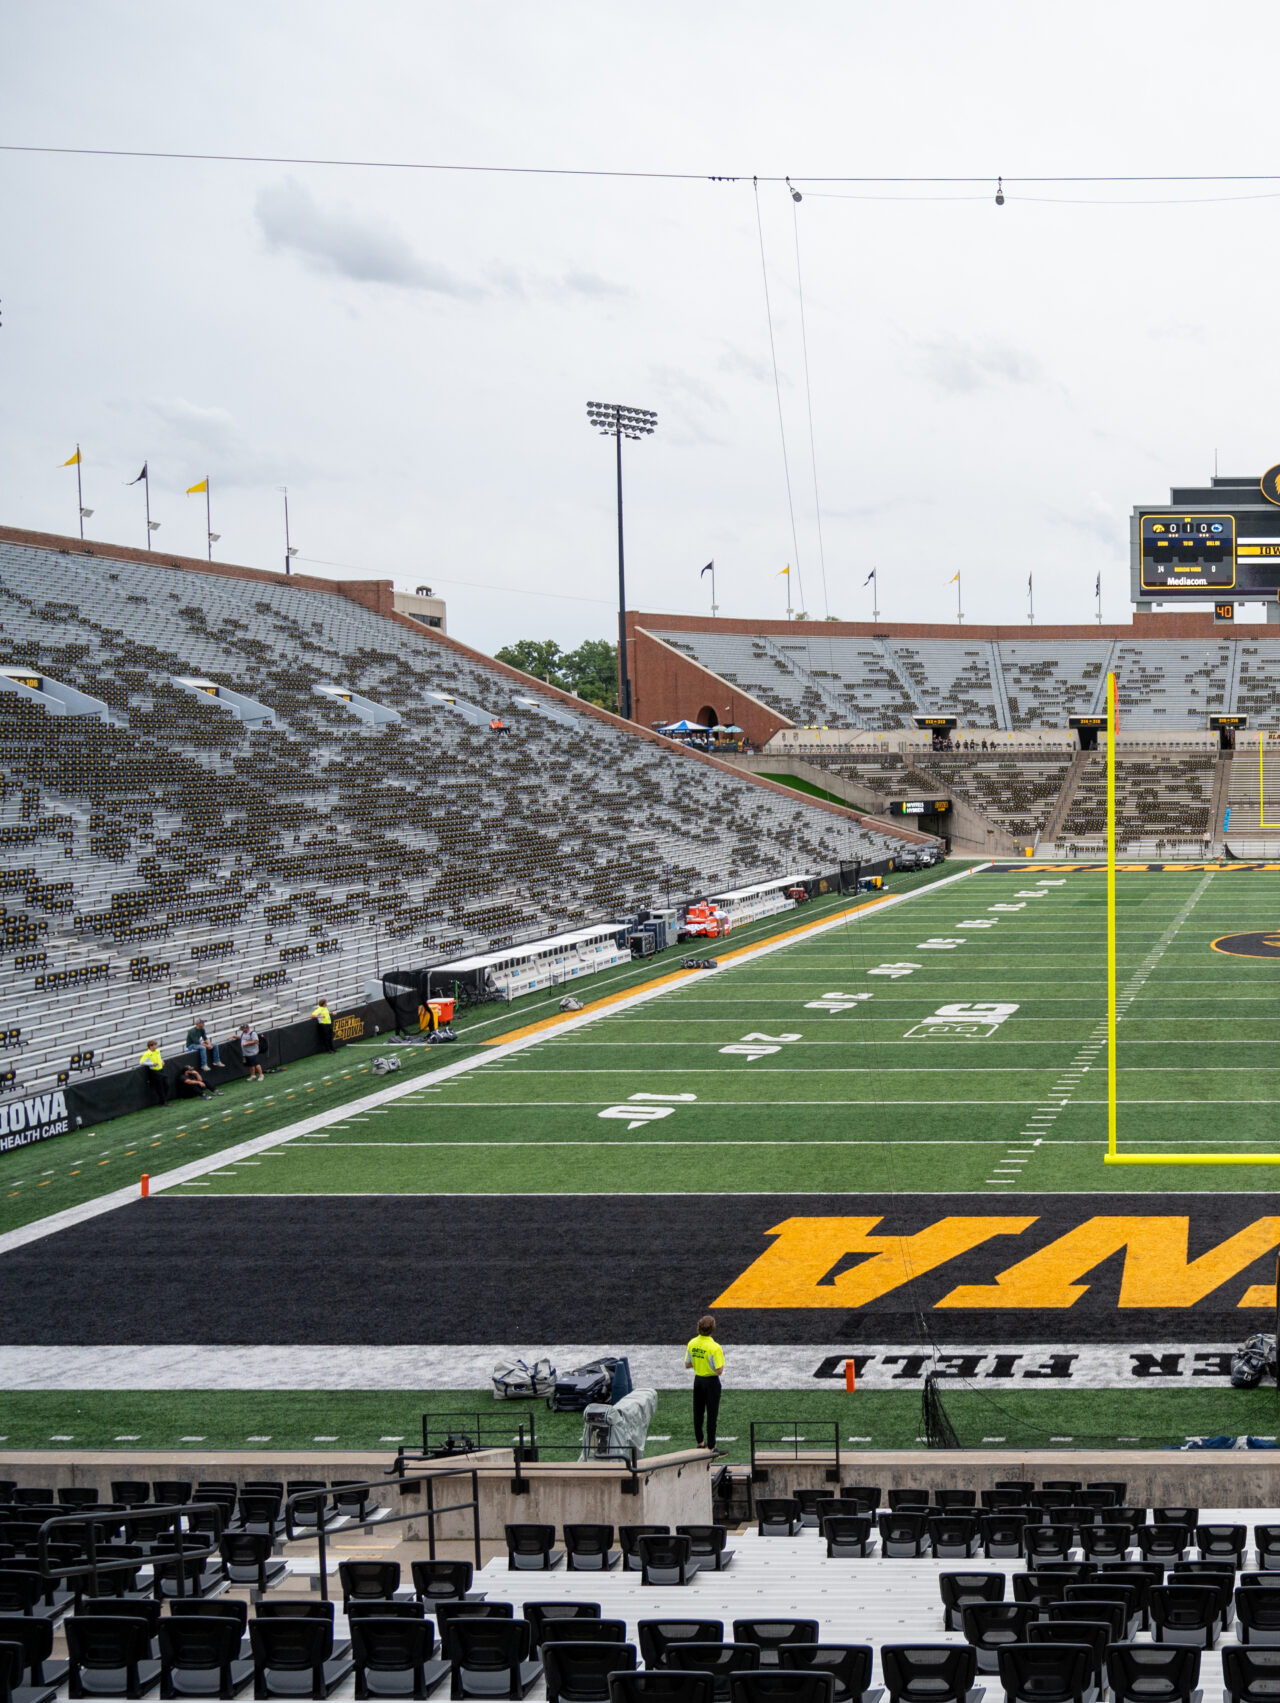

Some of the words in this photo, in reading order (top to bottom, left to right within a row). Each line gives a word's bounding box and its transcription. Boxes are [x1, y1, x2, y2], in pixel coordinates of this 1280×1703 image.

[1170, 524, 1177, 533] 0
[1201, 524, 1208, 533] 0
[1217, 606, 1232, 617] 40
[916, 938, 967, 949] 50
[867, 962, 923, 976] 40
[803, 992, 874, 1009] 30
[343, 1022, 364, 1039] IOWA
[718, 1032, 803, 1054] 20
[0, 1091, 68, 1135] IOWA
[597, 1092, 698, 1120] 10
[0, 1128, 40, 1151] HEALTH
[42, 1120, 69, 1138] CARE
[812, 1354, 1080, 1378] FIELD
